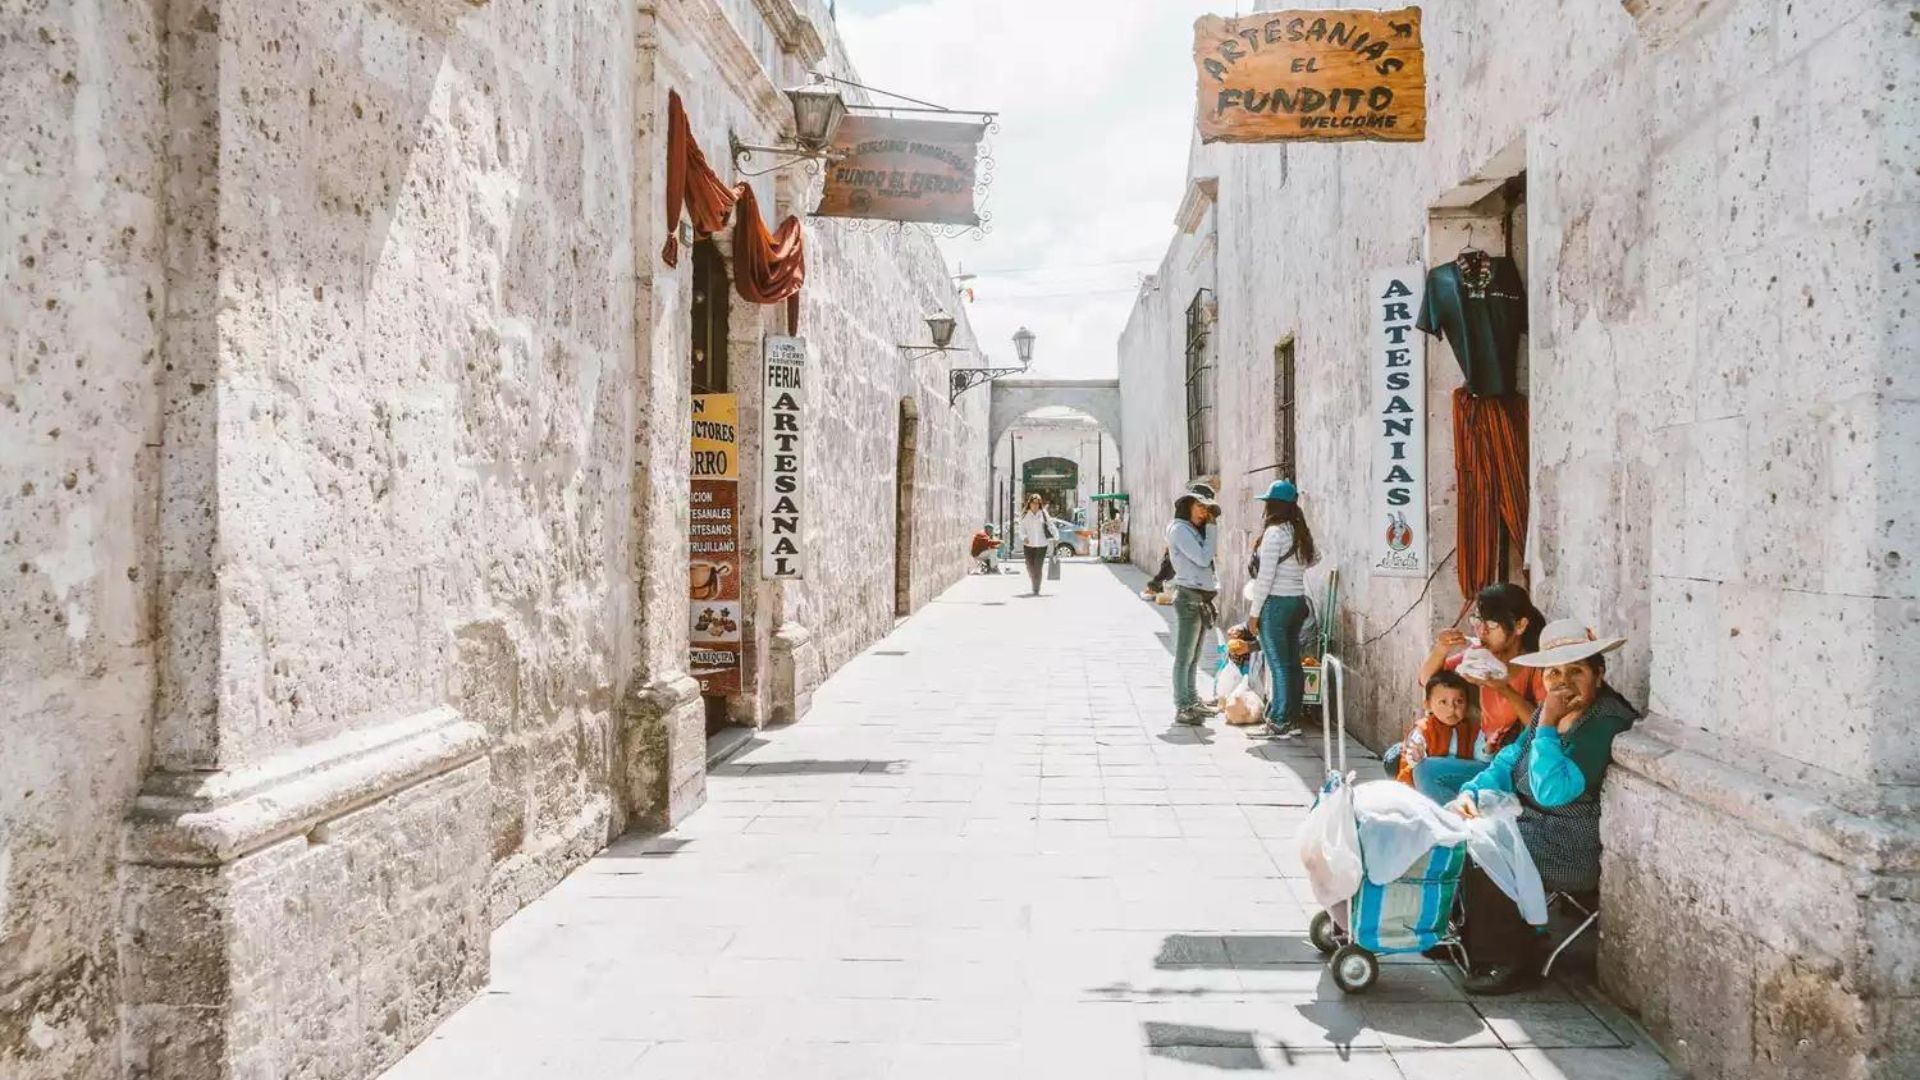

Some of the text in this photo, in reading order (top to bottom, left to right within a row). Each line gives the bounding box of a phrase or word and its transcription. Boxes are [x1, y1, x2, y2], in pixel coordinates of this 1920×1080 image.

[1202, 17, 1404, 82] ARTESANIAS
[1290, 57, 1319, 73] EL
[1217, 86, 1394, 116] FUNDITO
[1300, 115, 1398, 129] WELCOME
[768, 365, 801, 389] FERIA
[1381, 279, 1414, 506] ARTESANIAS
[771, 392, 800, 576] ARTESANAL
